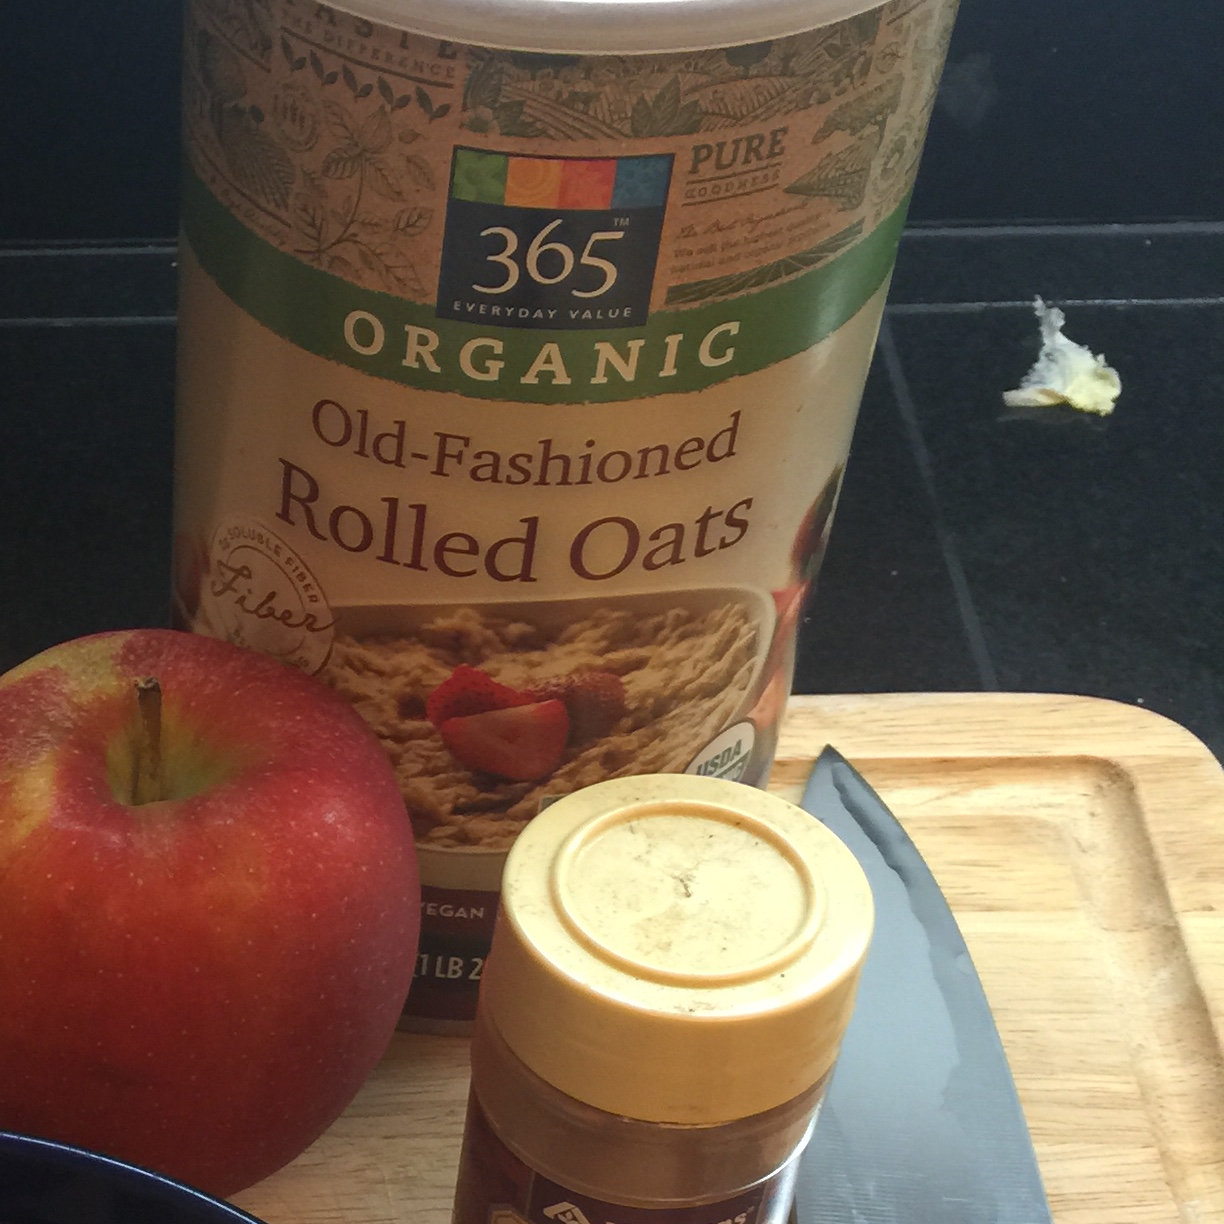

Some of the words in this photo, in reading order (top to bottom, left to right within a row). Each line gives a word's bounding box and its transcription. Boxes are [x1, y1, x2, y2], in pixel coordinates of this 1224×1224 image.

[688, 126, 789, 175] PURE
[472, 218, 625, 298] 365
[453, 301, 557, 319] EVERYDAY
[569, 306, 633, 320] VALUE
[343, 309, 741, 385] ORGANIC
[311, 399, 743, 487] Old-Fashioned
[275, 457, 540, 583] Rolled
[569, 496, 754, 582] Oats
[696, 739, 742, 777] USDA
[421, 902, 485, 919] EGAN
[416, 953, 430, 976] 1
[434, 955, 464, 979] LB
